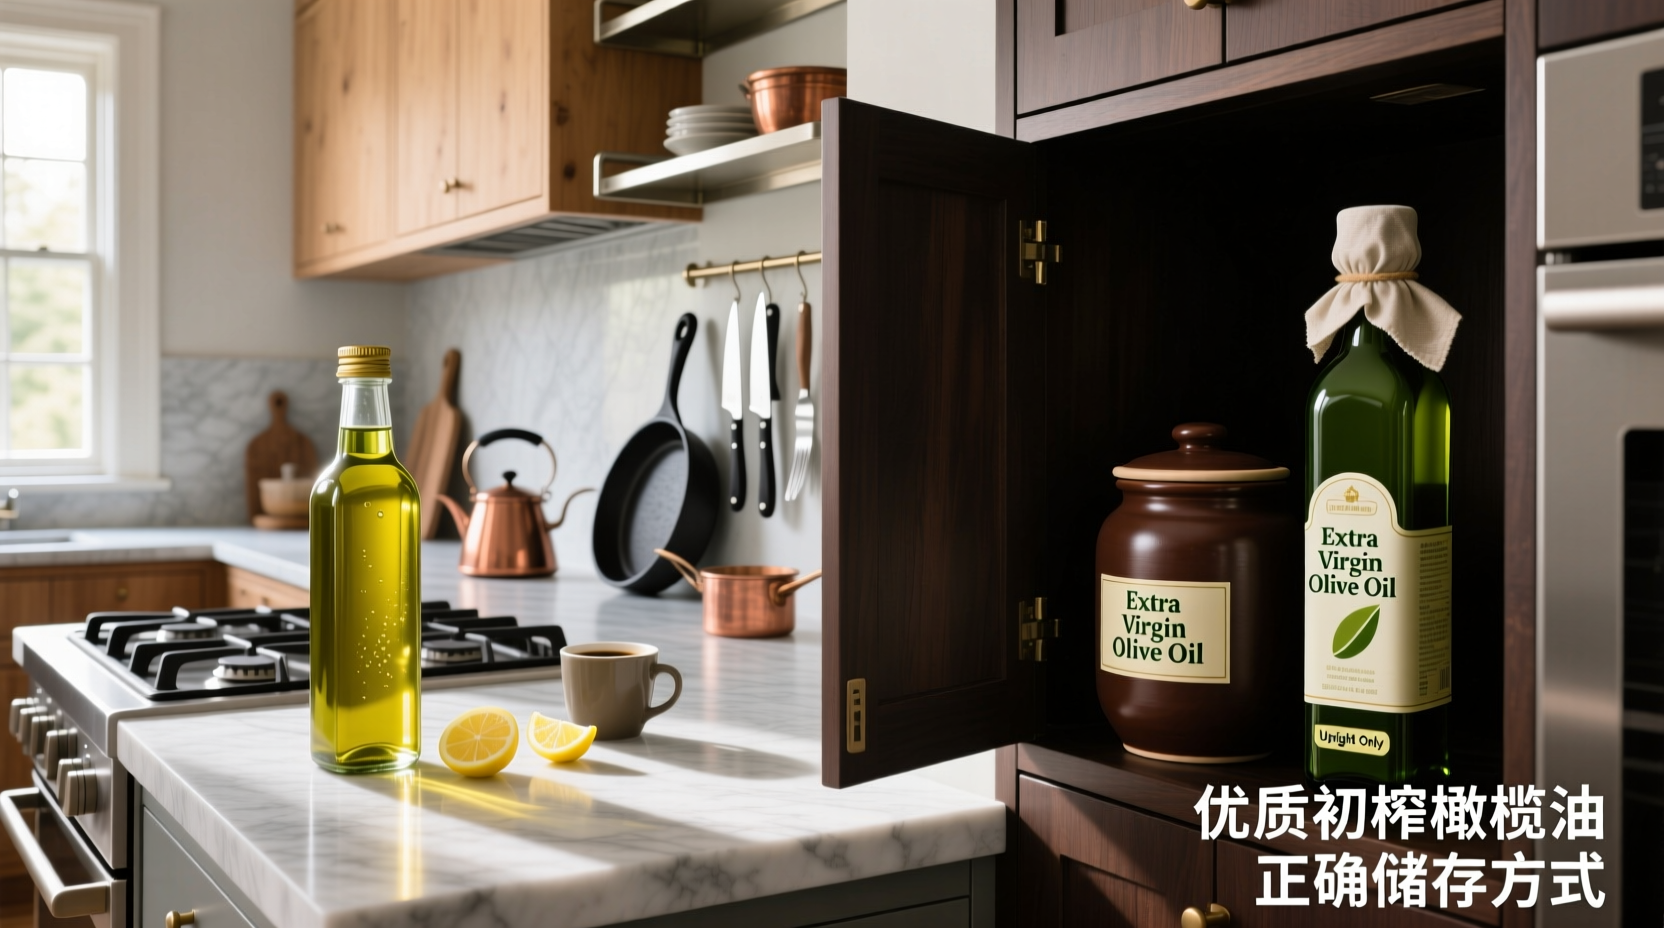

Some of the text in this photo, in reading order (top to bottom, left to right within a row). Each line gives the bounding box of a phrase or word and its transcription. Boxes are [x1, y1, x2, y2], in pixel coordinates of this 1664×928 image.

[1321, 527, 1378, 548] Extra
[1318, 550, 1383, 577] Virgin
[1309, 573, 1397, 598] Olive Oil
[1126, 590, 1181, 613] Extra
[1121, 613, 1186, 643] Virgin
[1112, 636, 1204, 665] Olive Oil
[1359, 735, 1384, 751] Only
